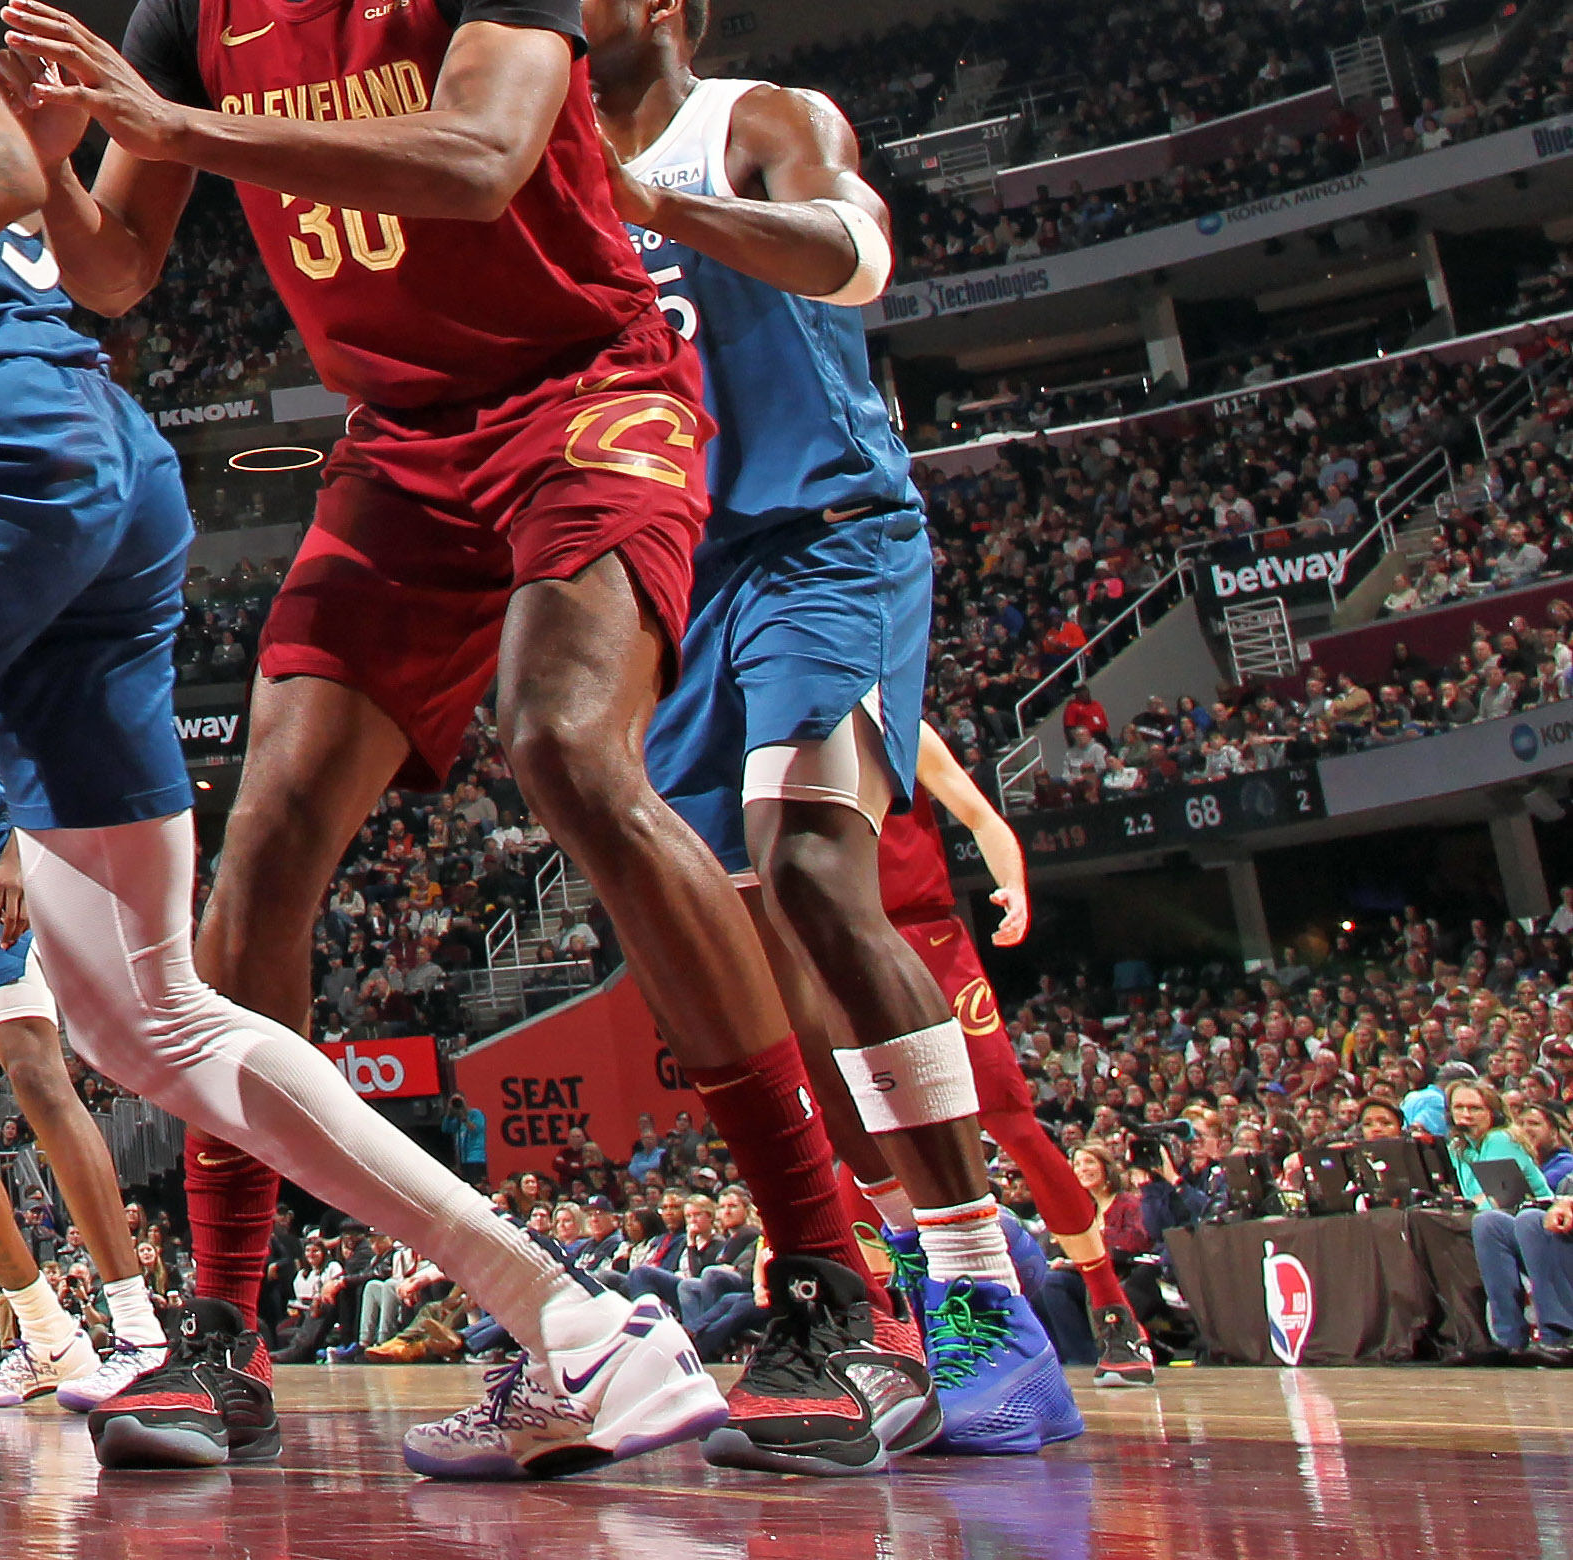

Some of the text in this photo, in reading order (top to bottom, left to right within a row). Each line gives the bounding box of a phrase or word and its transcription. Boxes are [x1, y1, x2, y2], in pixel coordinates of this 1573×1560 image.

[1226, 174, 1369, 225] KONICA MINOLTA
[281, 192, 406, 281] 30
[934, 268, 1049, 312] Technologies
[159, 400, 260, 427] KNOW.
[1211, 548, 1349, 597] betway
[1123, 813, 1154, 837] 2.2
[1184, 795, 1222, 829] 68
[1295, 791, 1310, 812] 2
[500, 1075, 584, 1110] SEAT
[872, 1070, 896, 1092] 5
